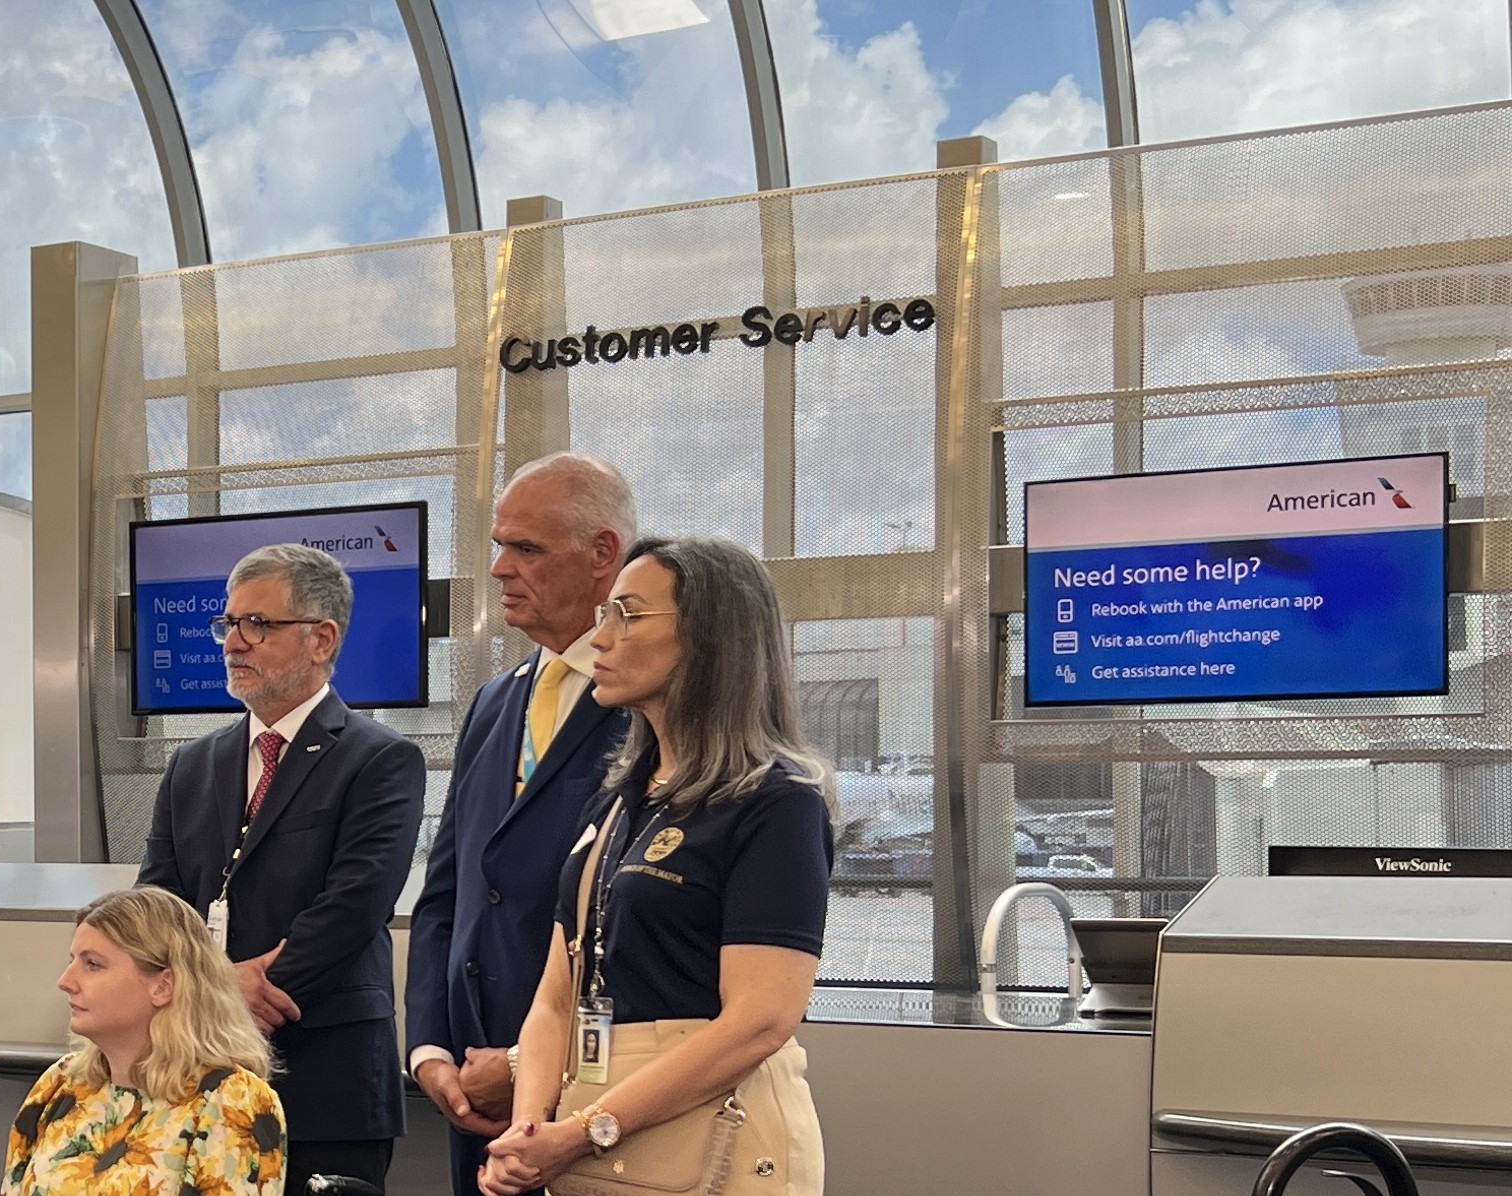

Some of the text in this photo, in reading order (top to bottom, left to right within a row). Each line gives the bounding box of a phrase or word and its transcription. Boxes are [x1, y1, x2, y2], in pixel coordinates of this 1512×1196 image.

[499, 295, 936, 374] Customer Service
[1267, 489, 1376, 512] American
[1053, 556, 1262, 588] Need some help?
[154, 594, 196, 614] Need
[1091, 595, 1324, 617] Rebook with the American app
[1091, 628, 1281, 648] Visit aa.com/flightchange
[1091, 661, 1236, 679] Get assistance here
[180, 678, 199, 690] Get
[1375, 857, 1452, 872] ViewSonic
